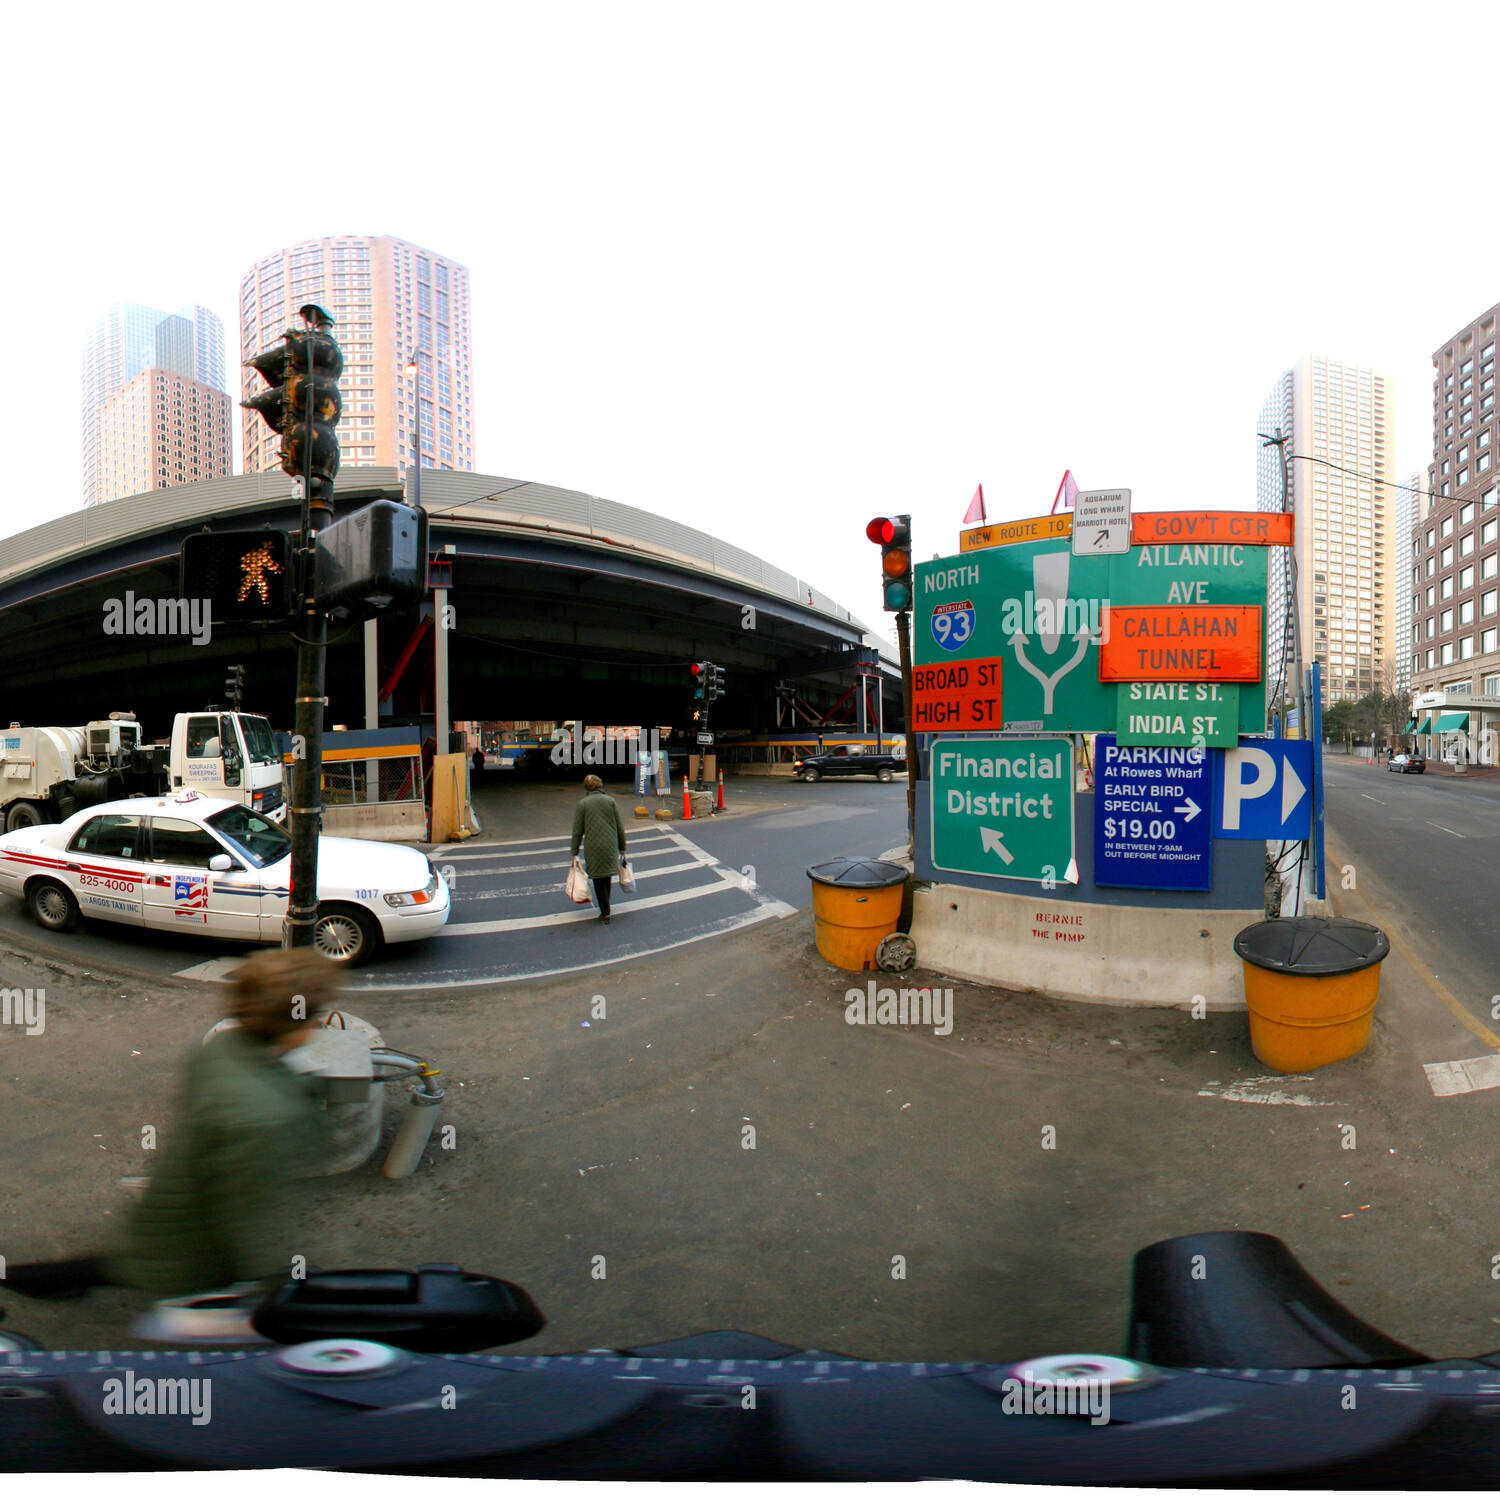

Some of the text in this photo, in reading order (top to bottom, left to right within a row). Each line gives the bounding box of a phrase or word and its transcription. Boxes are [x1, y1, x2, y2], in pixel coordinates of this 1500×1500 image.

[1084, 494, 1122, 503] AQUARIUM
[1080, 506, 1125, 516] LONG WHARF
[968, 520, 1064, 546] NEW ROUTE TO
[1076, 518, 1128, 528] MARRIOTT HOTEL
[1155, 516, 1269, 536] GOV'T CTR
[1138, 546, 1244, 567] ATLANTIC
[924, 564, 980, 594] NORTH
[1168, 581, 1209, 604] AVE
[938, 602, 968, 612] INTERSTATE
[935, 612, 970, 643] 93
[1124, 617, 1238, 638] CALLAHAN
[1138, 649, 1221, 670] TUNNEL
[915, 664, 998, 691] BROAD ST
[1130, 682, 1222, 702] STATE ST.
[916, 700, 996, 724] HIGH ST
[1130, 716, 1220, 736] INDIA ST.
[1106, 746, 1202, 764] PARKING
[940, 752, 1062, 779] Financial
[1104, 767, 1202, 778] At Rowes Wharf
[1104, 784, 1184, 797] EARLY BIRD
[1222, 747, 1276, 830] P
[948, 790, 1053, 819] District
[1104, 800, 1162, 812] SPECIAL
[1104, 818, 1176, 840] $19.00
[1105, 842, 1112, 850] IN
[1158, 844, 1182, 852] 7-9AM
[1124, 852, 1158, 860] BEFORE
[1159, 853, 1201, 861] MIDNIGHT
[80, 874, 134, 892] 825-4000
[356, 889, 379, 898] 1017
[1036, 912, 1083, 926] BERNIE
[1032, 928, 1085, 942] THE PIMP
